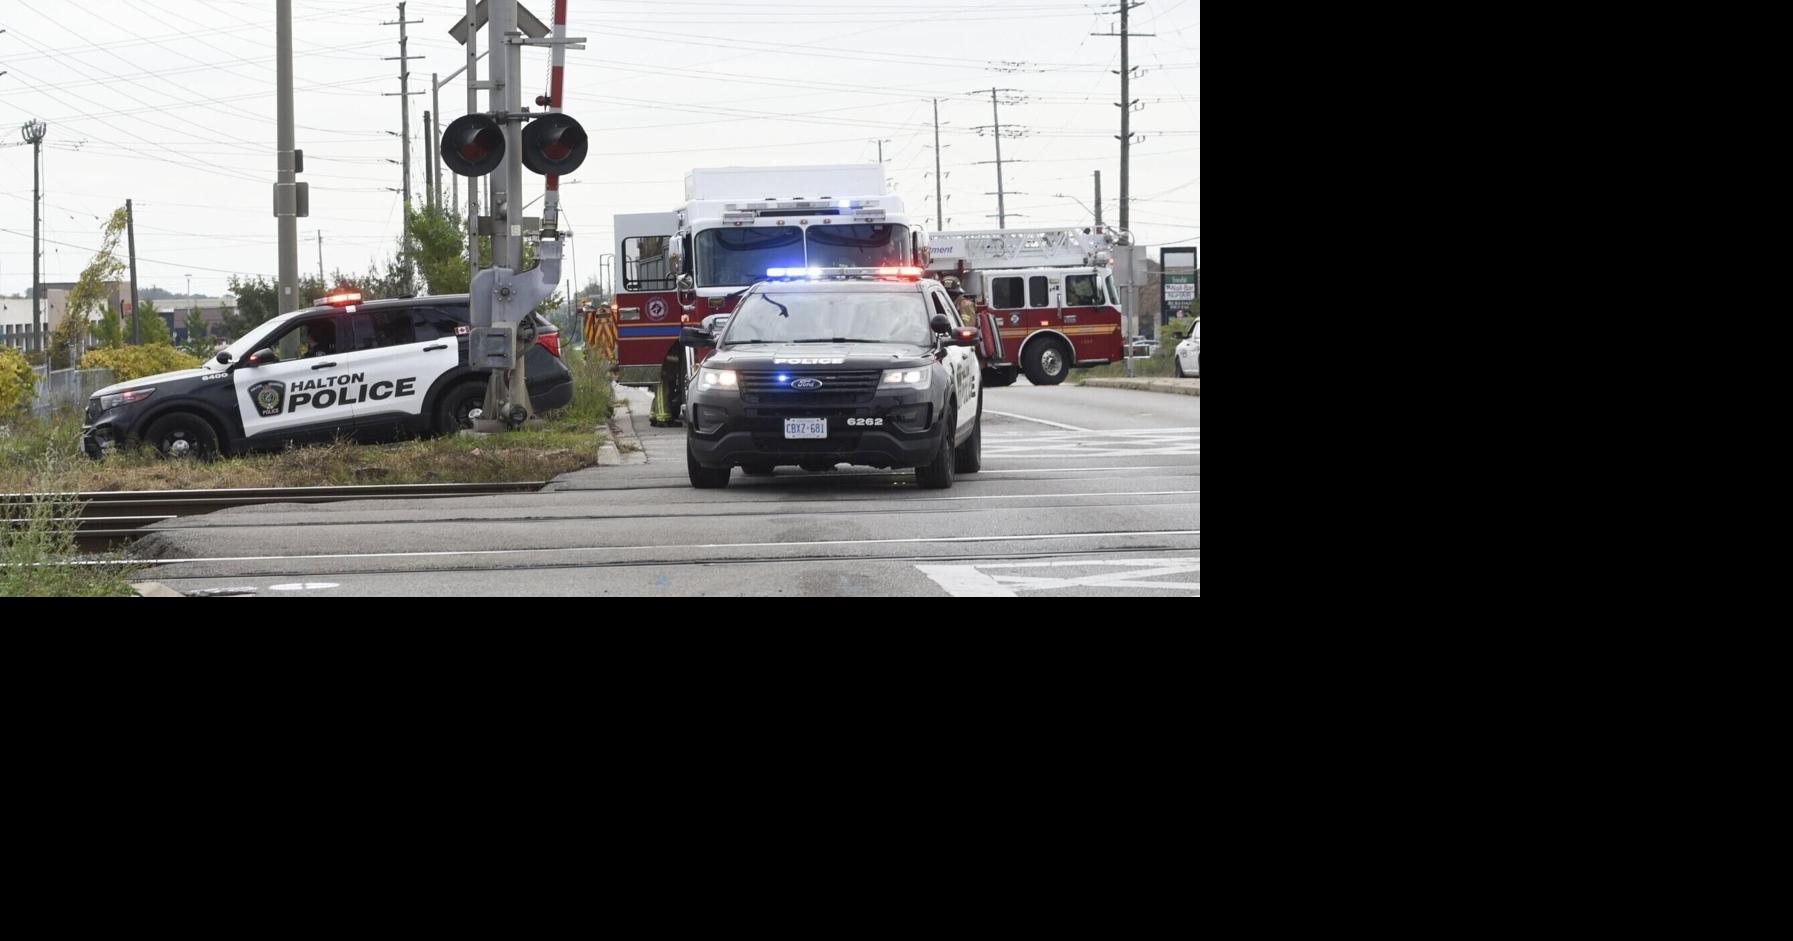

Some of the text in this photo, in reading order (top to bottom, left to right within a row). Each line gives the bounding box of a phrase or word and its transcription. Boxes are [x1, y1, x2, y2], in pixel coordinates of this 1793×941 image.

[291, 372, 364, 392] HALTON
[288, 377, 416, 413] POLICE
[847, 418, 883, 426] 6262
